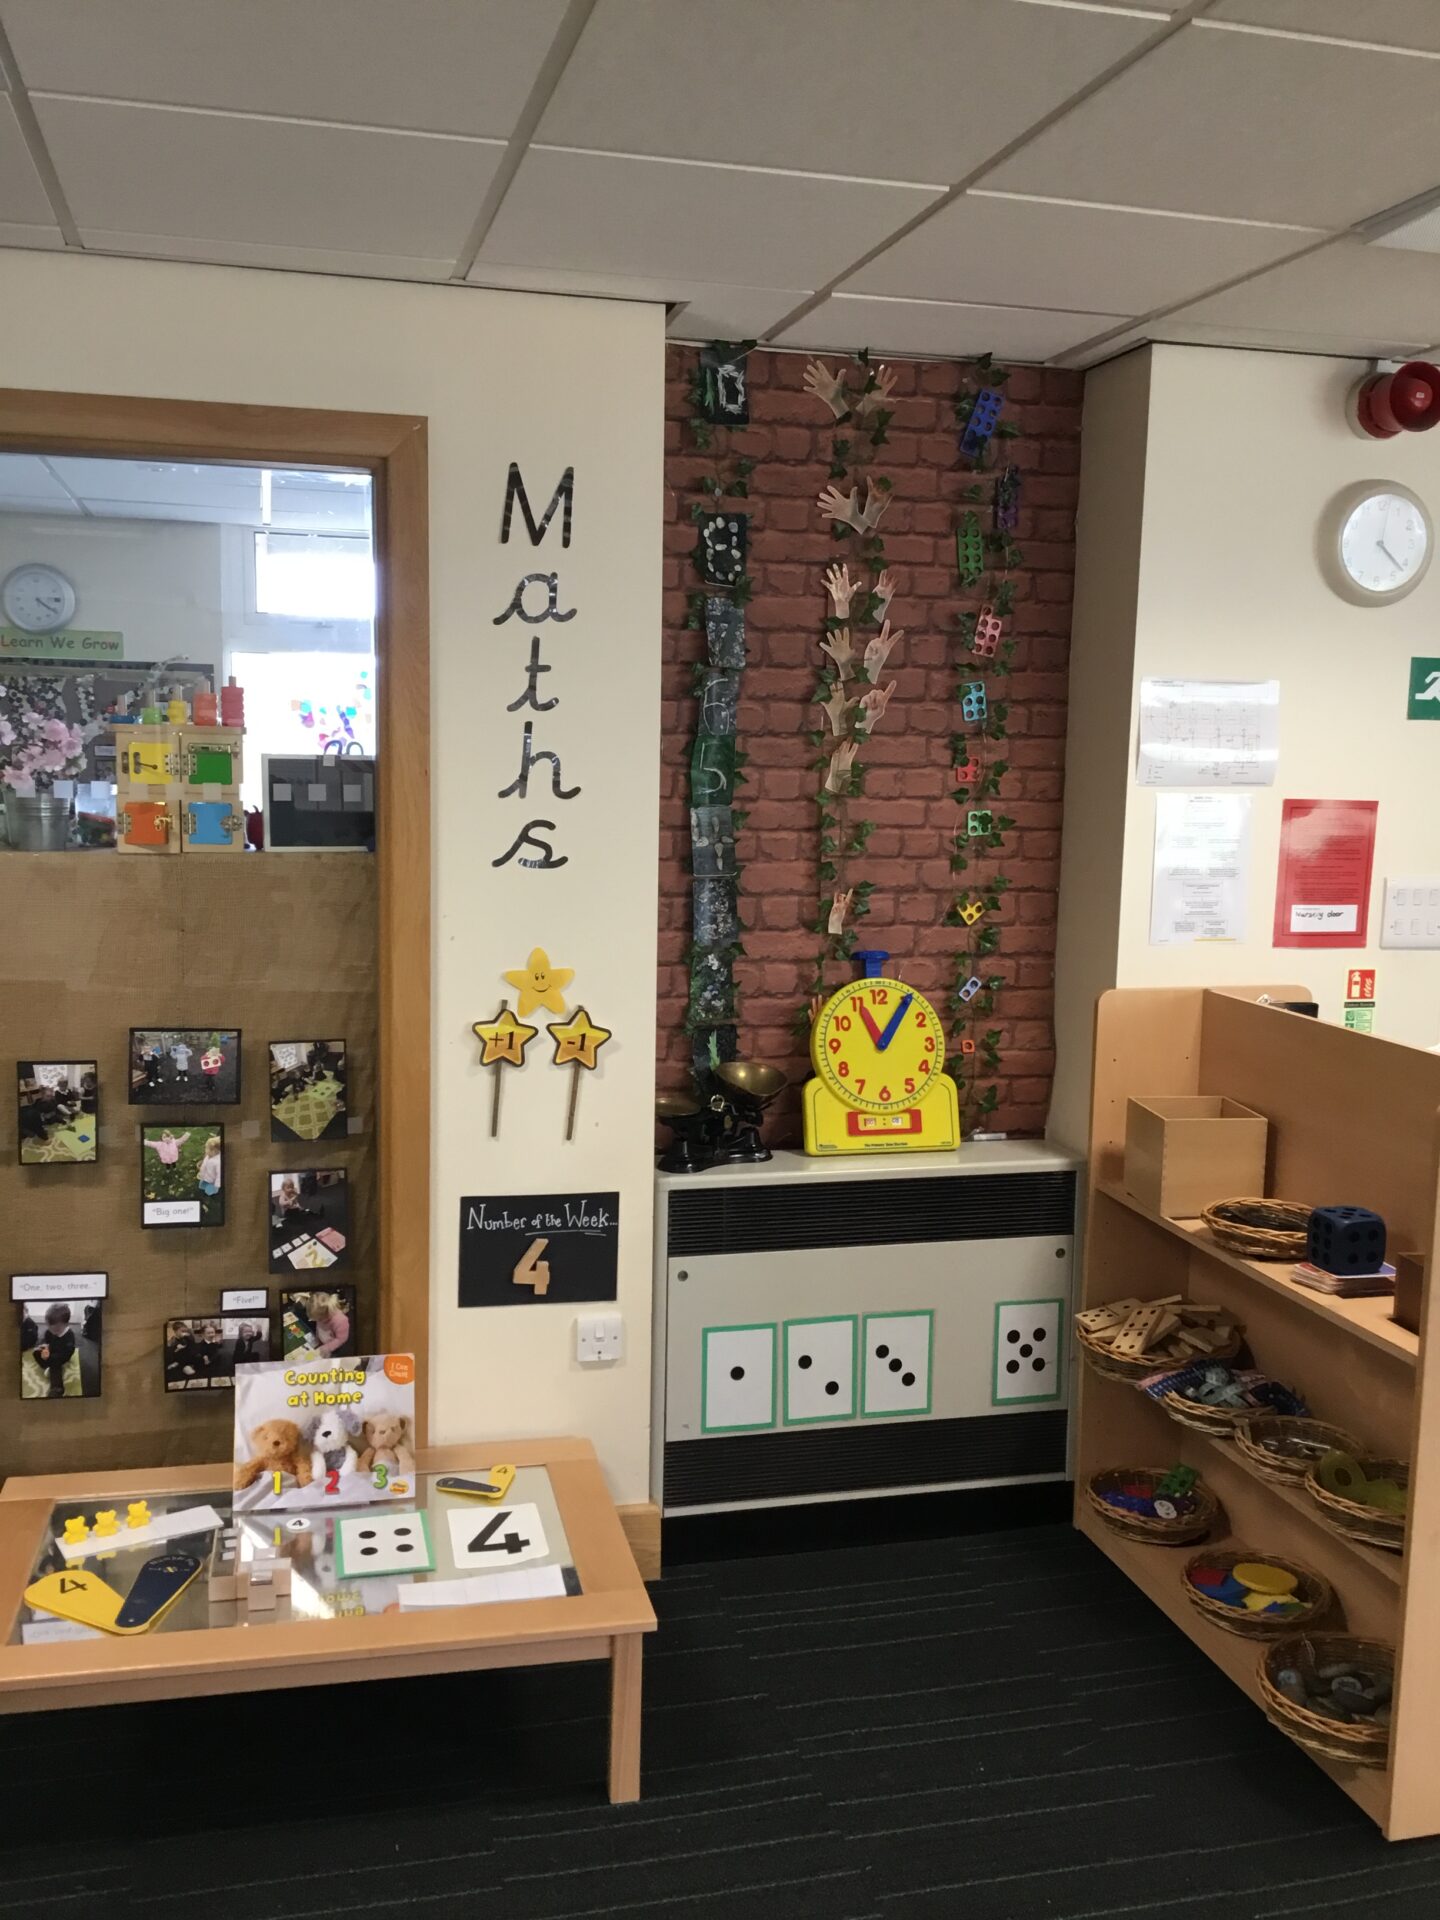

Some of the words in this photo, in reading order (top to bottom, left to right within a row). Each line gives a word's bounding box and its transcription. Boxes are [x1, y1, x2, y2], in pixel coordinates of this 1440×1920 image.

[1, 634, 43, 648] Learn
[50, 636, 75, 649] We
[82, 637, 119, 650] Grow
[869, 988, 889, 1005] 12
[833, 1015, 852, 1032] 10
[915, 1011, 927, 1028] 2
[489, 1031, 515, 1051] +1
[566, 1032, 587, 1052] -1
[828, 1038, 842, 1055] 9
[924, 1036, 936, 1053] 3
[838, 1061, 850, 1078] 8
[918, 1059, 931, 1075] 4
[855, 1079, 866, 1095] 7
[879, 1085, 891, 1102] 6
[904, 1077, 916, 1094] 5
[467, 1203, 528, 1231] Number
[531, 1213, 543, 1229] of
[545, 1213, 563, 1228] the
[512, 1237, 551, 1296] 4
[284, 1368, 367, 1386] Counting
[287, 1391, 309, 1408] at
[314, 1390, 363, 1406] Home
[272, 1470, 282, 1496] 1
[325, 1468, 340, 1496] 2
[373, 1463, 388, 1490] 3
[467, 1510, 531, 1555] 4
[59, 1577, 89, 1595] 4
